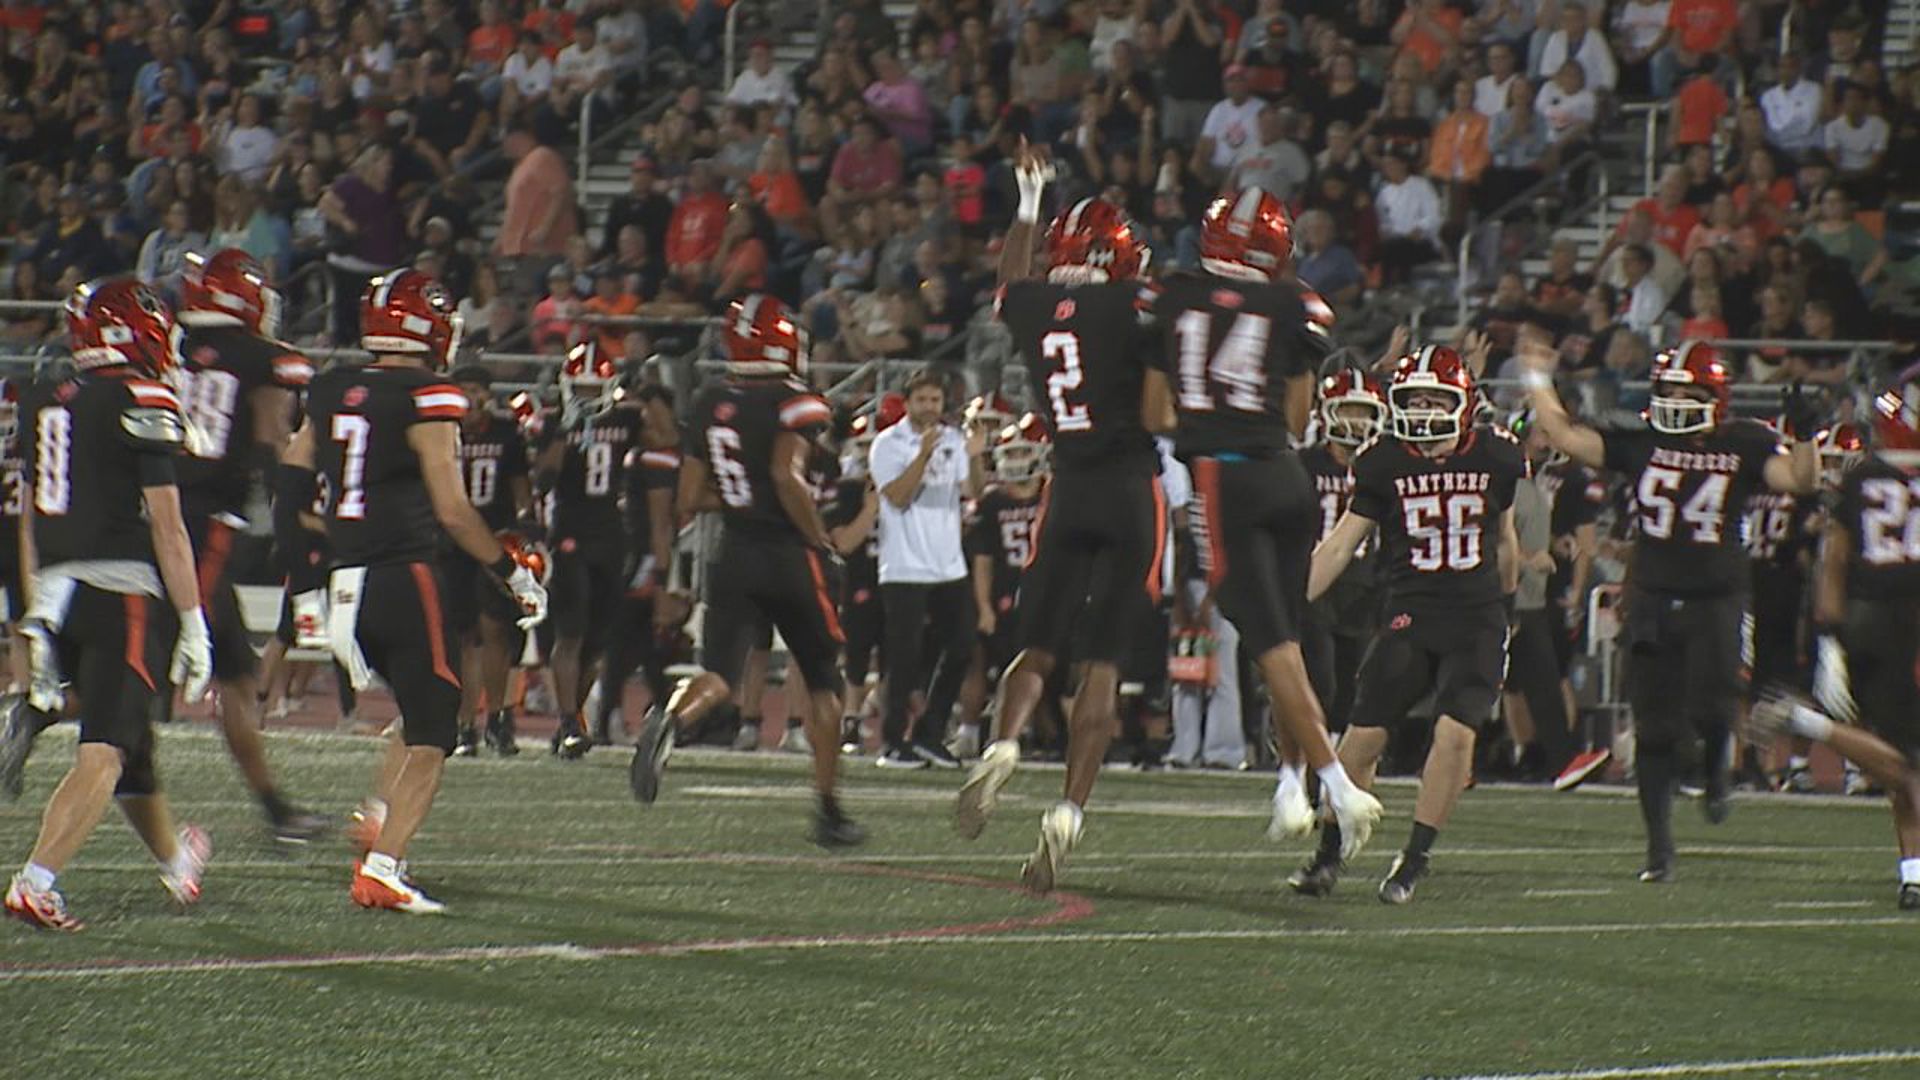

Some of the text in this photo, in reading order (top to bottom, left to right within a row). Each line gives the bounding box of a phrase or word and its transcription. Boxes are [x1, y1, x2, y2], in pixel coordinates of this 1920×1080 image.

[1042, 332, 1091, 431] 2
[1176, 310, 1270, 411] 14
[331, 415, 370, 519] 7
[707, 426, 751, 507] 6
[1395, 472, 1490, 496] PANTHERS
[1638, 465, 1731, 543] 54
[1403, 493, 1484, 570] 56
